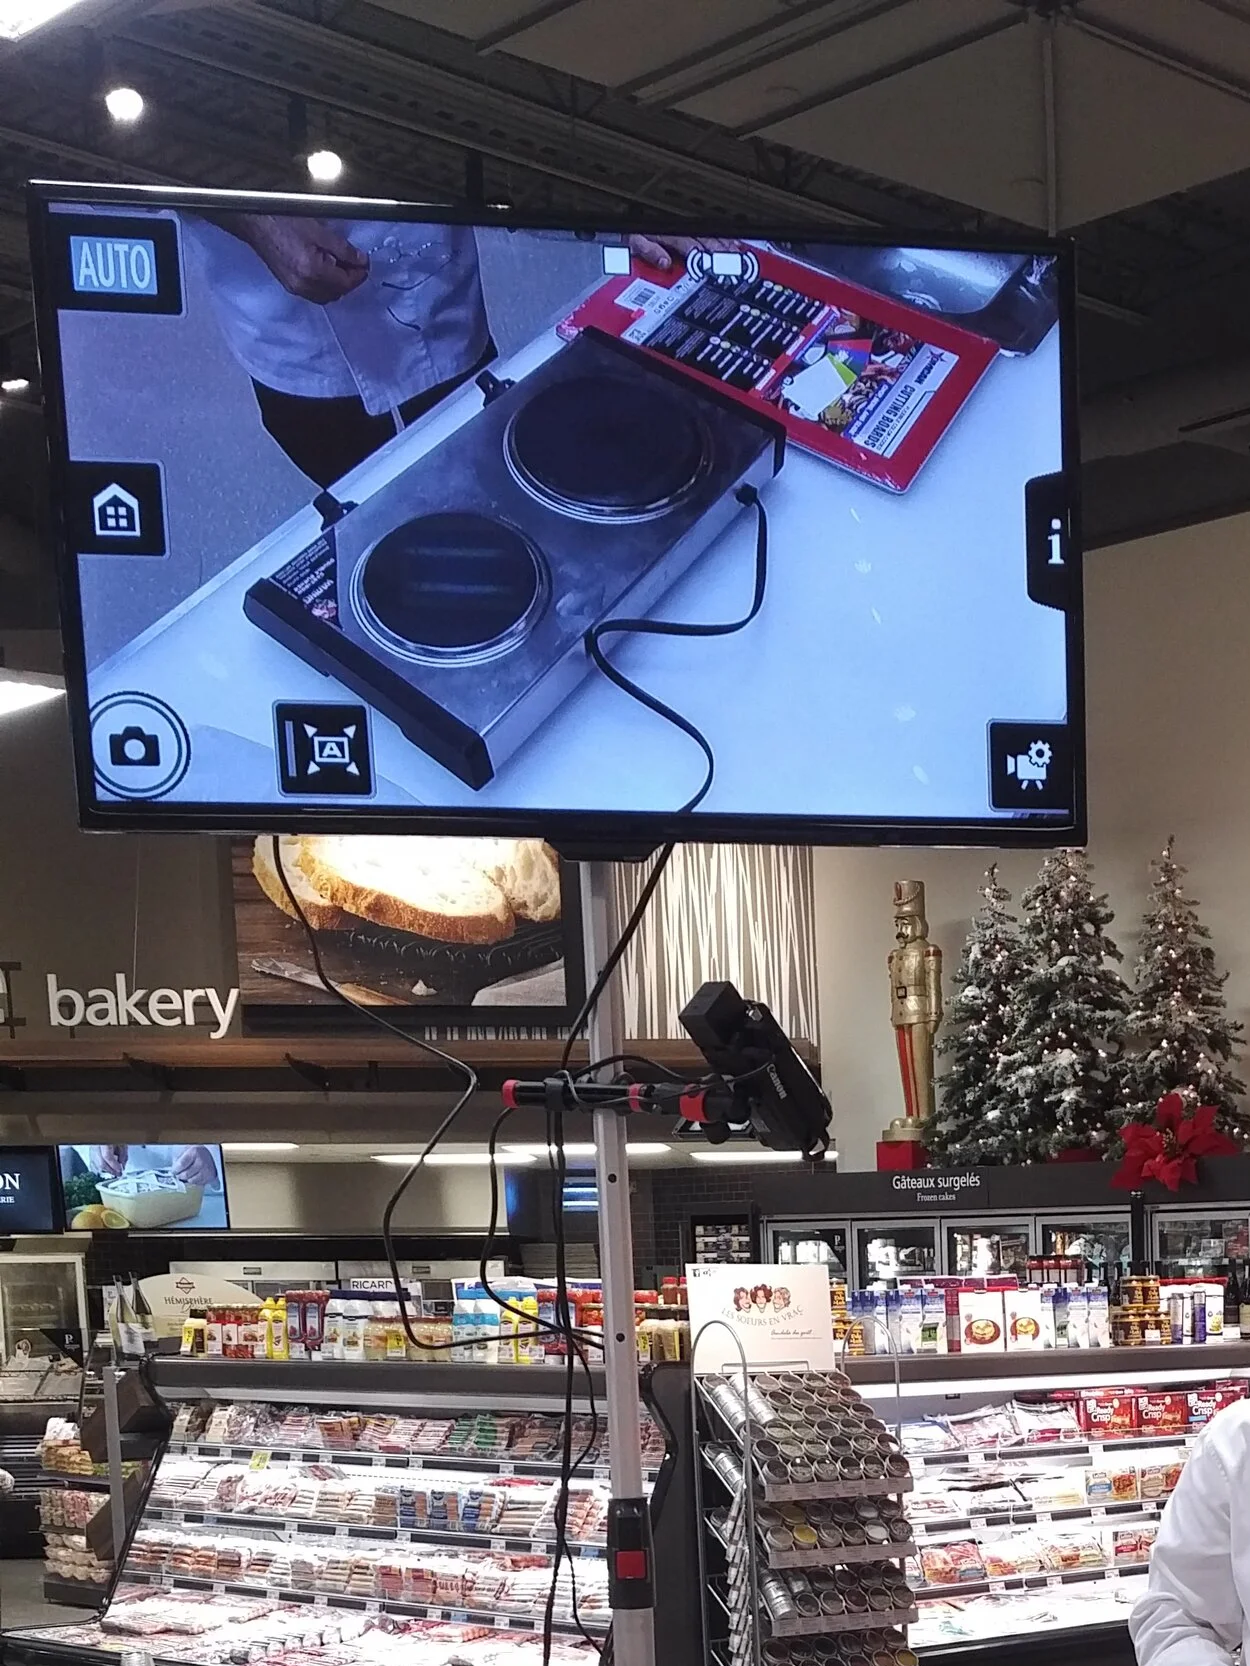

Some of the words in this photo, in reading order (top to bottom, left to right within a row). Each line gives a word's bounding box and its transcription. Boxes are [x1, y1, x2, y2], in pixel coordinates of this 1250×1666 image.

[79, 241, 151, 289] AUTO
[892, 384, 916, 419] CUTTING
[864, 415, 893, 448] BOARDS
[47, 973, 239, 1040] bakery
[892, 1175, 935, 1189] Gâteaux
[937, 1172, 981, 1191] surgelés
[917, 1192, 938, 1201] Frozen
[938, 1191, 956, 1200] cakes
[164, 1295, 213, 1305] HÉMISPHÈRE
[721, 1308, 735, 1320] LES
[769, 1316, 781, 1326] EN
[1091, 1413, 1111, 1423] Crisp
[1142, 1410, 1162, 1420] Crisp
[1192, 1406, 1214, 1417] Crisp
